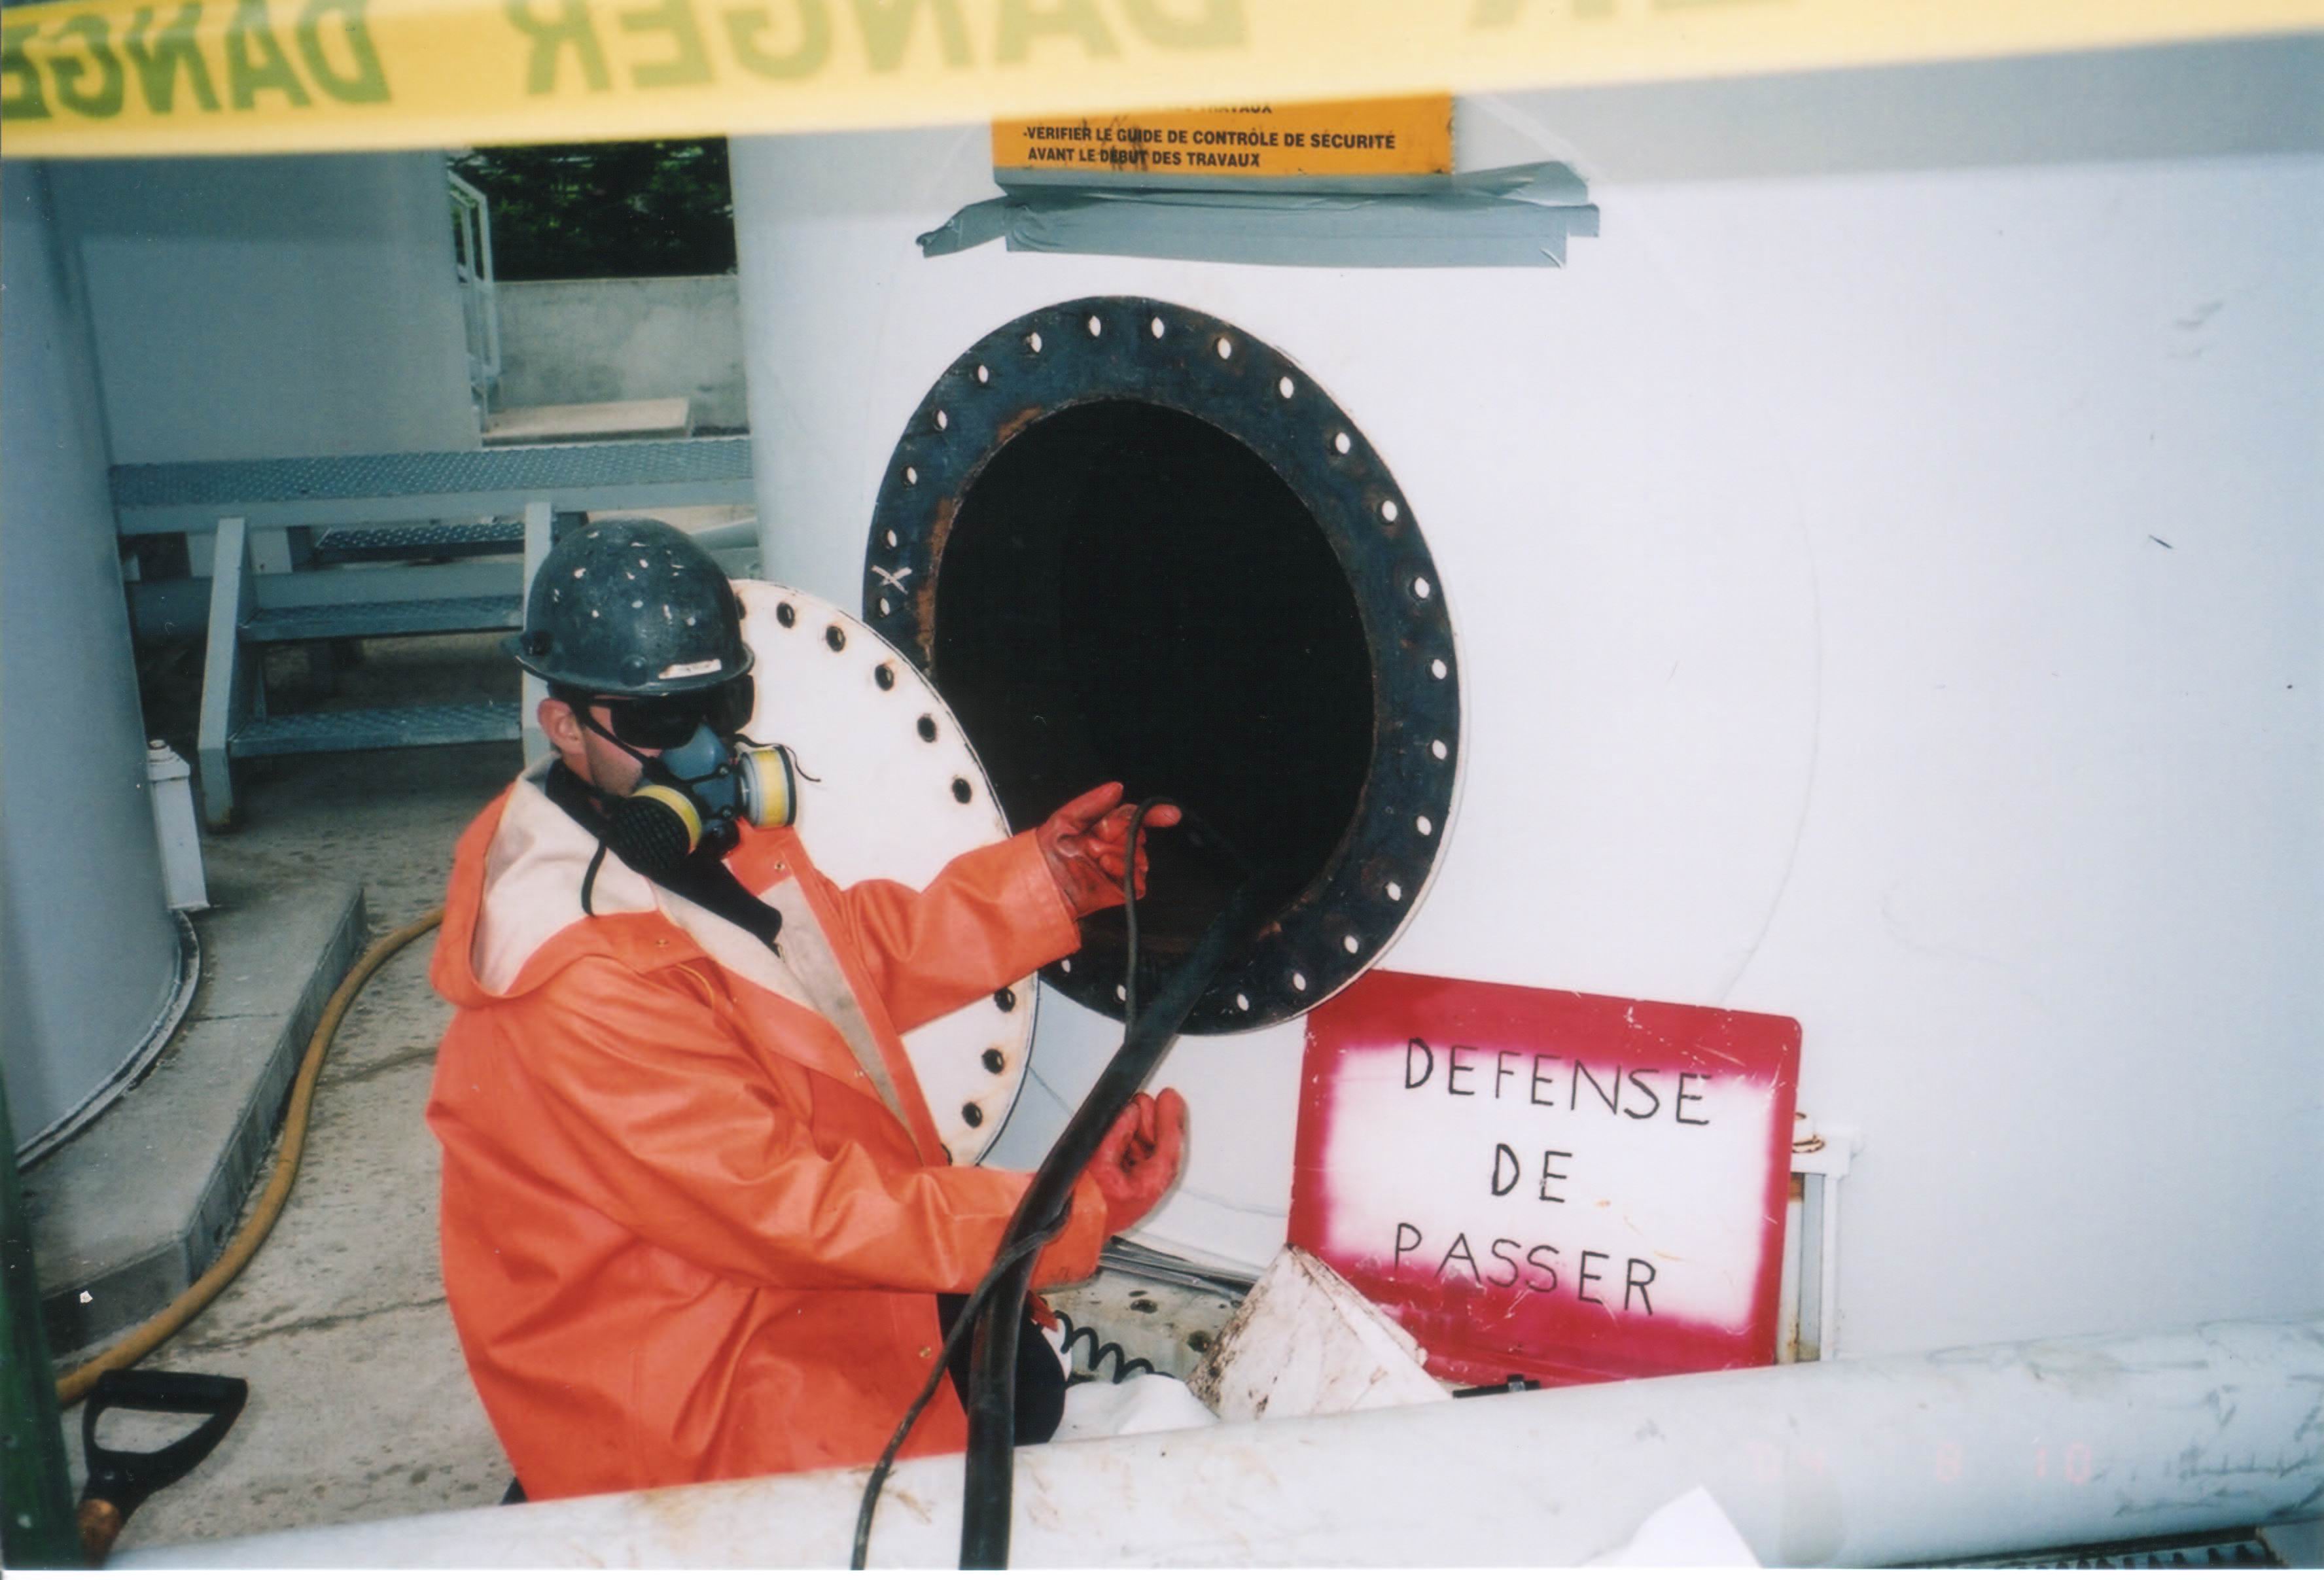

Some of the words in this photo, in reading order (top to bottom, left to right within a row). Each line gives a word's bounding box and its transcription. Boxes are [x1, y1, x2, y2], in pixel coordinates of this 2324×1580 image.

[1028, 147, 1074, 161] AVANT
[1079, 149, 1095, 162] LE
[1152, 151, 1182, 165] DES
[1187, 152, 1260, 167] TRAVAUX
[1096, 128, 1112, 141] LE
[1117, 128, 1162, 143] GUIDE
[1167, 130, 1188, 144] DE
[1284, 133, 1305, 147] DE
[1405, 1037, 1712, 1126] DEFENSE
[1491, 1142, 1573, 1203] DE
[1394, 1222, 1657, 1316] PASSER
